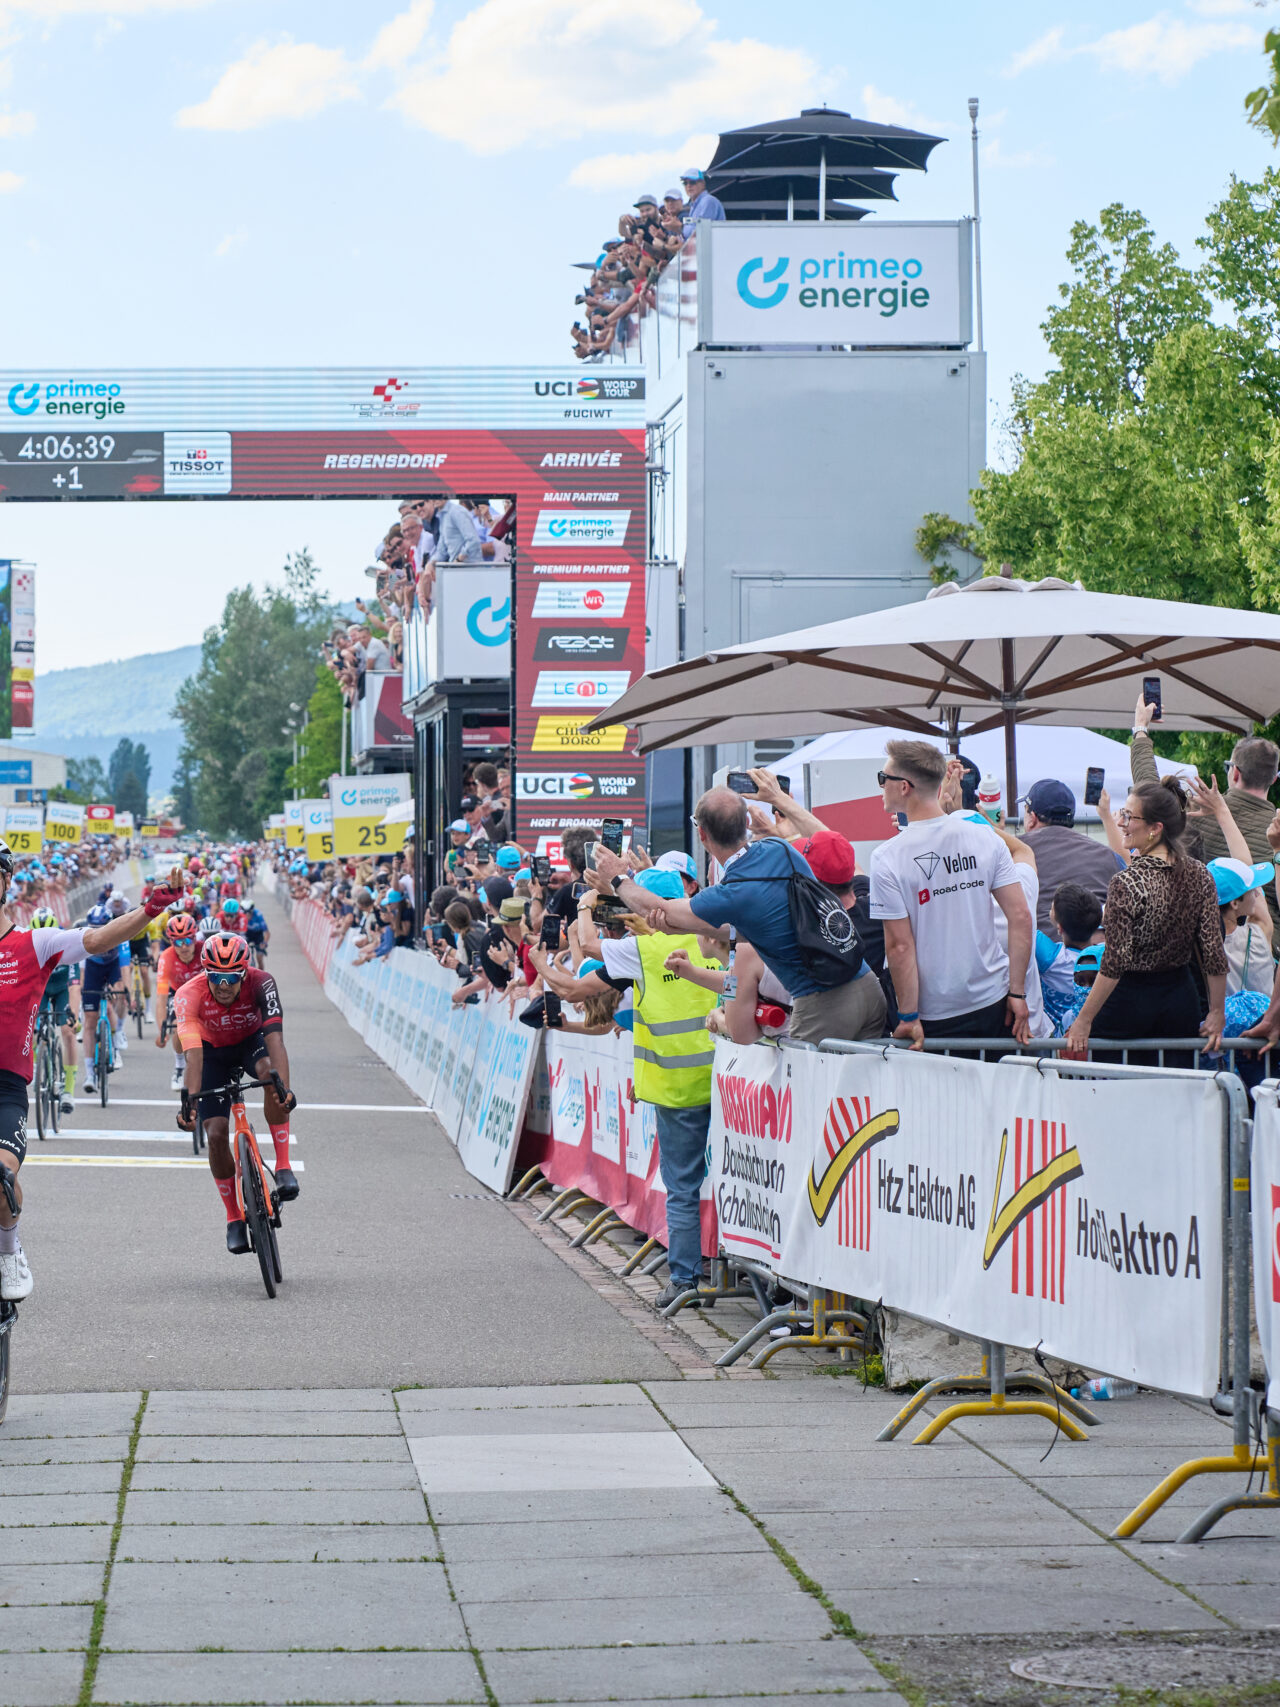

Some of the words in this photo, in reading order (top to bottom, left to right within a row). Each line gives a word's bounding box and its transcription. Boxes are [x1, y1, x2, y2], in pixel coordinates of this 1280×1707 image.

[800, 251, 923, 284] primeo
[799, 280, 930, 317] energie
[46, 380, 121, 399] primeo
[535, 382, 571, 396] UCI
[604, 380, 636, 389] WORLD
[605, 388, 629, 397] TOUR
[46, 397, 125, 419] energie
[564, 409, 613, 418] #UCIWT
[18, 436, 115, 459] 4:06:39
[169, 461, 224, 471] TISSOT
[324, 454, 447, 468] REGENSDORF
[540, 450, 622, 467] ARRIVÉE
[52, 467, 83, 489] +1
[543, 492, 571, 501] MAIN
[572, 492, 619, 501] PARTNER
[570, 517, 612, 528] primeo
[570, 527, 614, 540] energie
[533, 565, 582, 574] PREMIUM
[583, 565, 630, 574] PARTNER
[523, 778, 564, 794] UCI
[598, 777, 636, 786] WORLD
[600, 786, 627, 795] TOUR
[530, 818, 557, 827] HOST
[52, 824, 75, 839] 100
[359, 826, 387, 847] 25
[9, 833, 30, 849] 75
[322, 835, 333, 854] 5
[943, 853, 977, 874] Velon
[933, 884, 958, 896] Road
[960, 880, 984, 890] Code
[262, 979, 280, 1016] INEOS
[205, 1013, 258, 1027] INEOS
[908, 1163, 952, 1225] Elektro
[956, 1173, 975, 1231] AG
[1185, 1215, 1201, 1279] A
